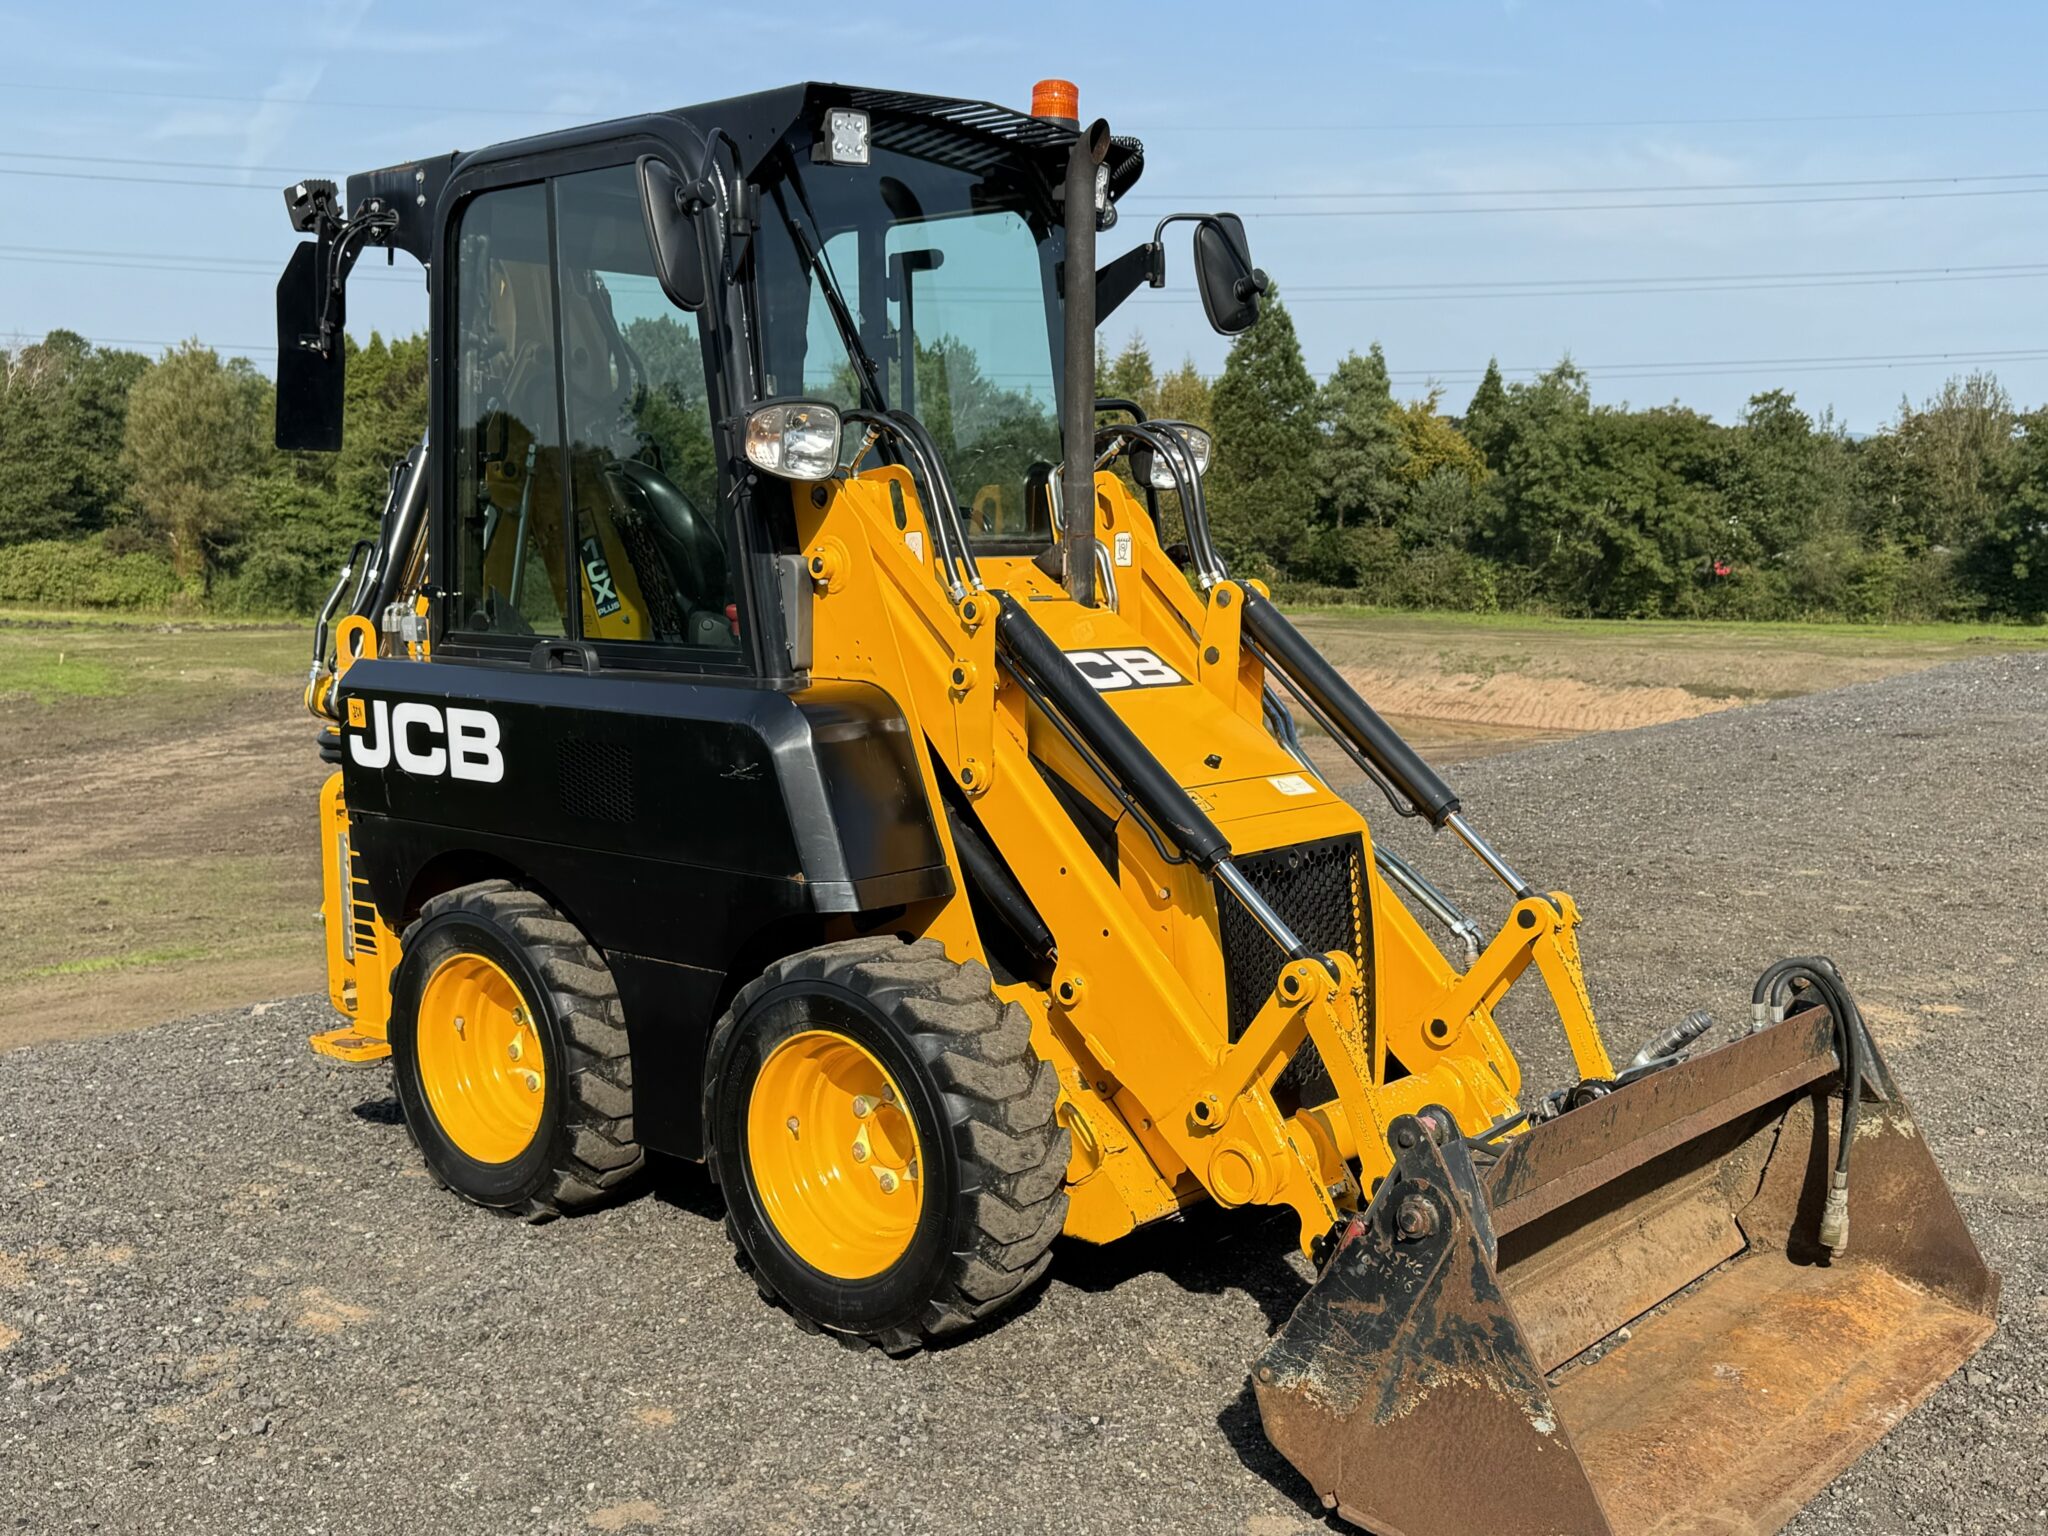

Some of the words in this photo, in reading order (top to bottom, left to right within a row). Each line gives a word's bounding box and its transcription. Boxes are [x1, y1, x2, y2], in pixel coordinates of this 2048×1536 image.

[583, 538, 616, 605] 1CX
[598, 602, 620, 615] PLUS
[1065, 650, 1182, 689] CB
[349, 700, 504, 783] JCB
